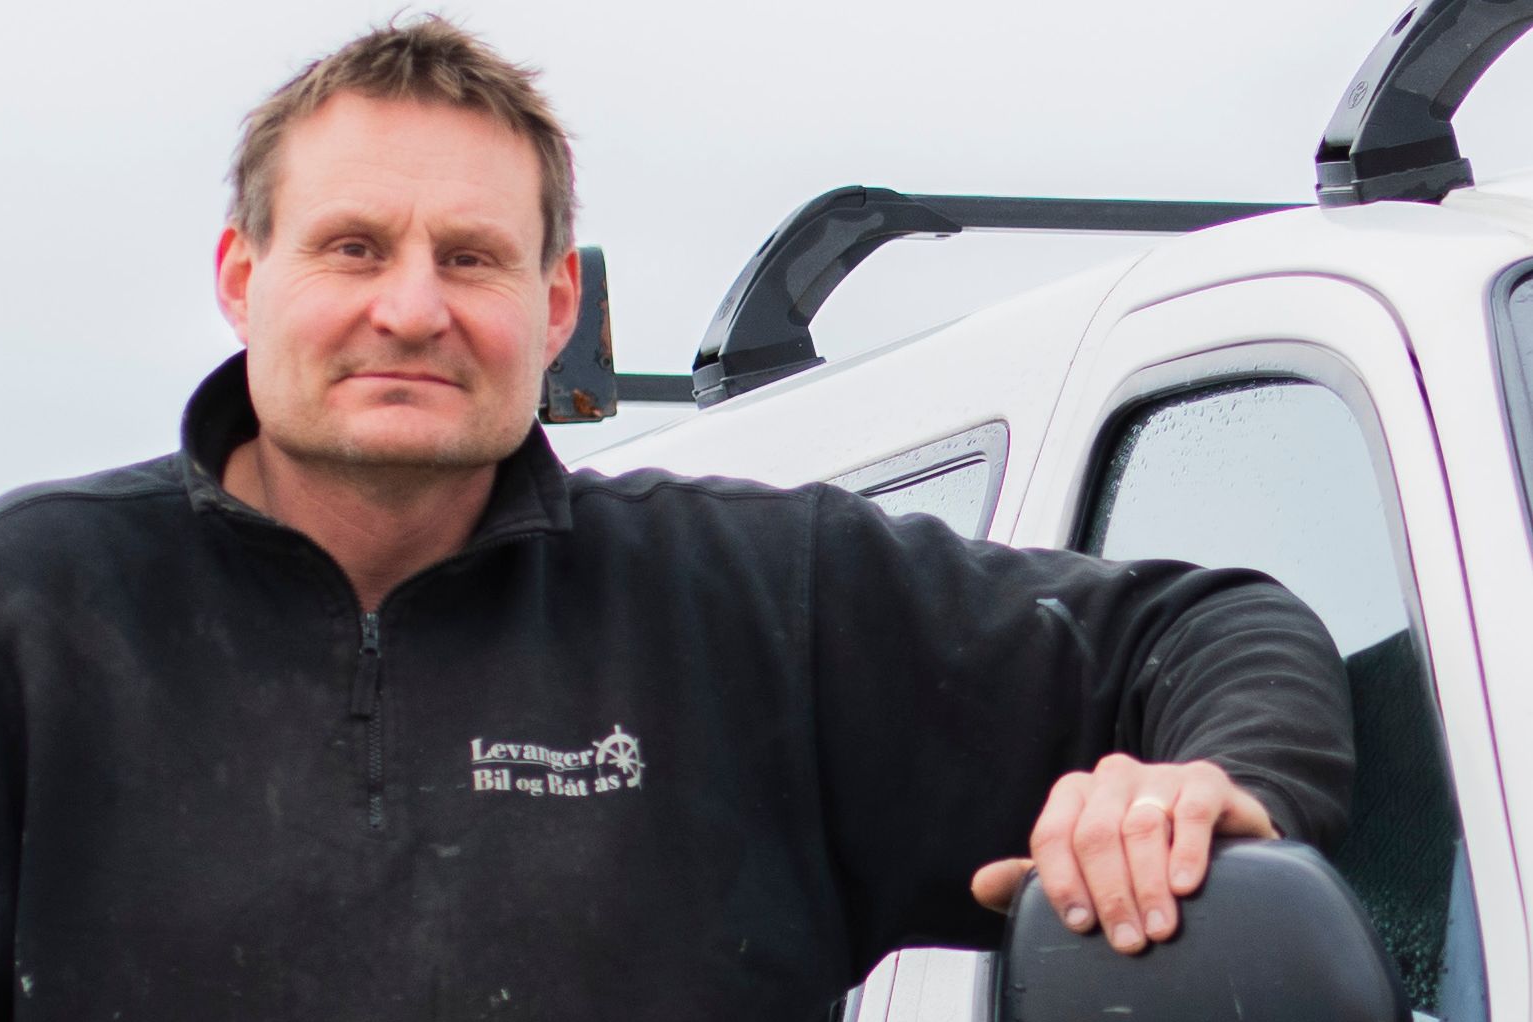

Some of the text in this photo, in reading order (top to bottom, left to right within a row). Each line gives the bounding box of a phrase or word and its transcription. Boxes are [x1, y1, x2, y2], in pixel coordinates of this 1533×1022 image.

[470, 737, 594, 772] Levanger
[473, 769, 621, 796] Bil og Båt as
